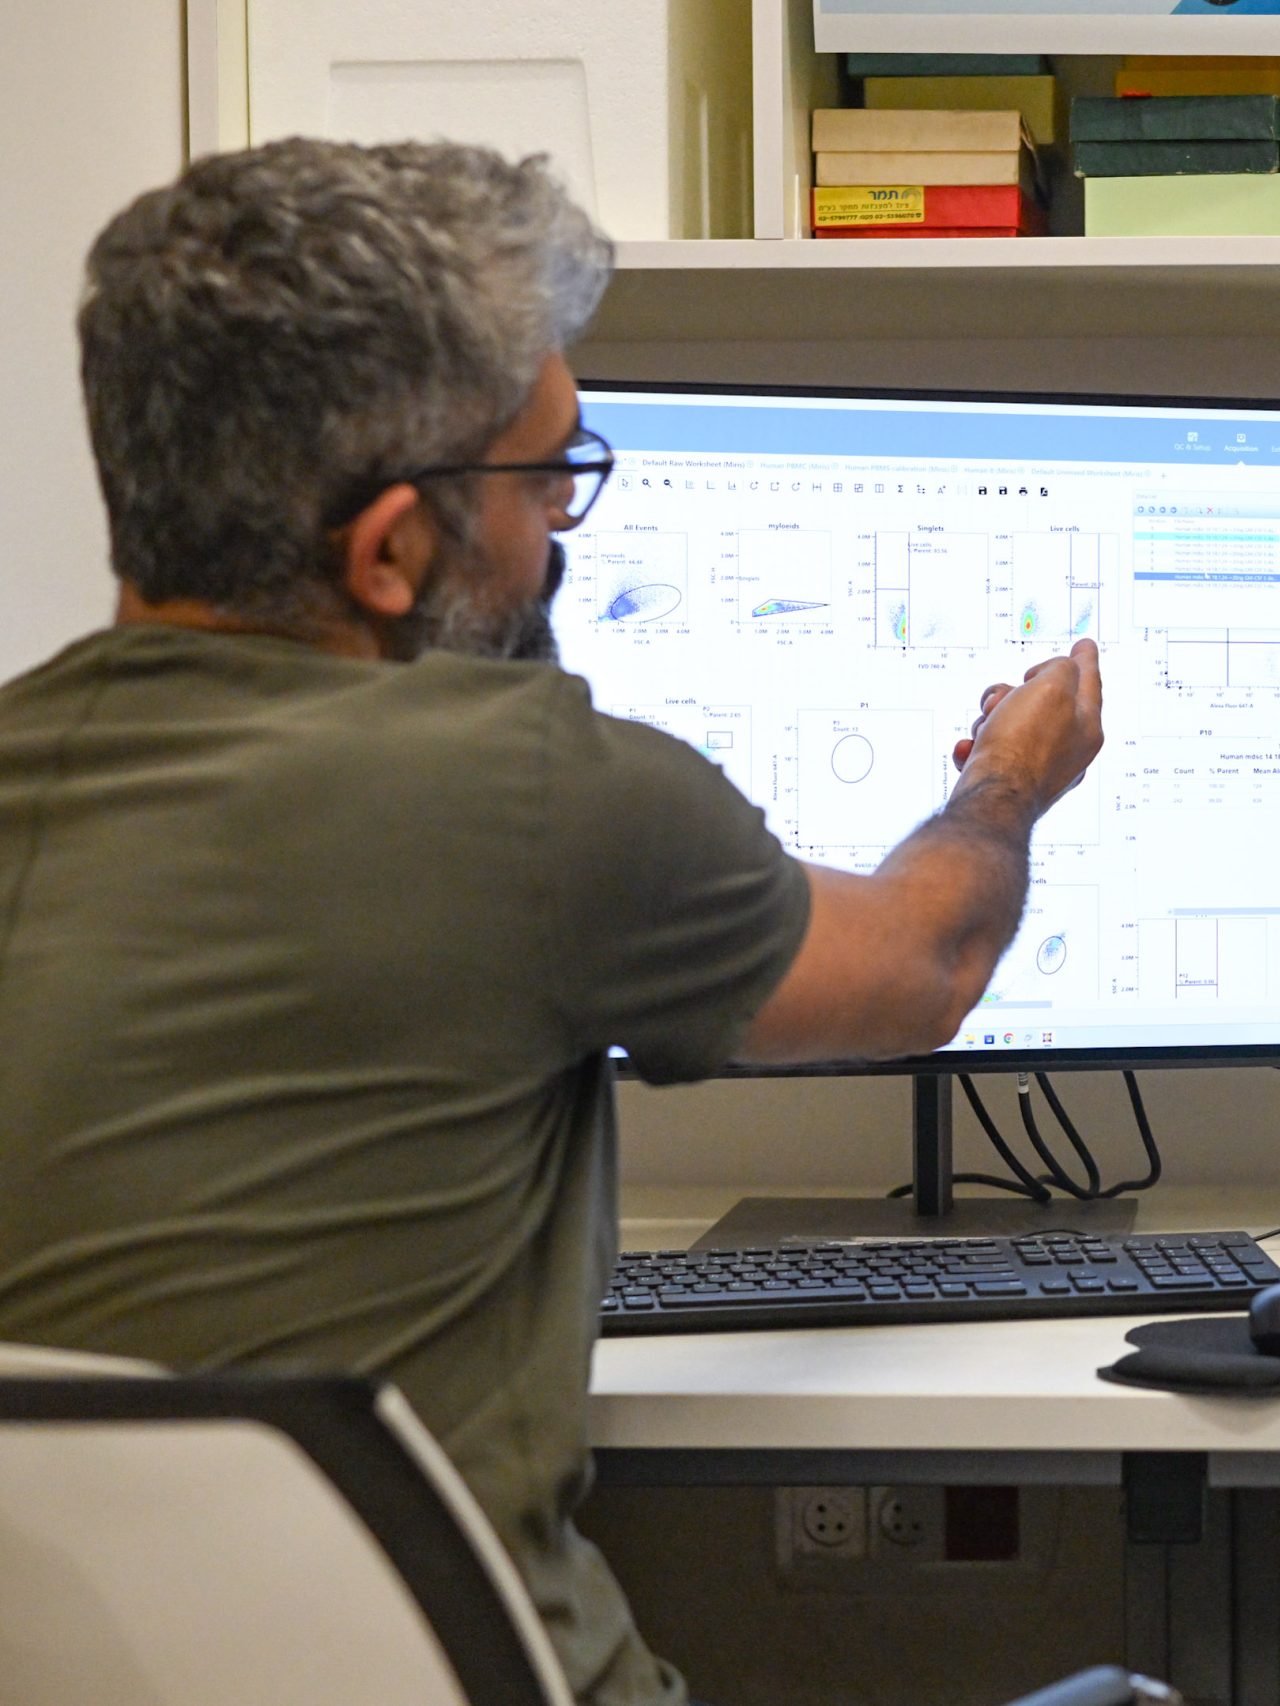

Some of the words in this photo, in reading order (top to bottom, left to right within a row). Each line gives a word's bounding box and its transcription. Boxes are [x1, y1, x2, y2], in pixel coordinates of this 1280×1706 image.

[868, 190, 898, 200] תמר
[1224, 444, 1258, 453] Acquisition
[642, 458, 668, 466] Default
[917, 525, 944, 533] Singlets
